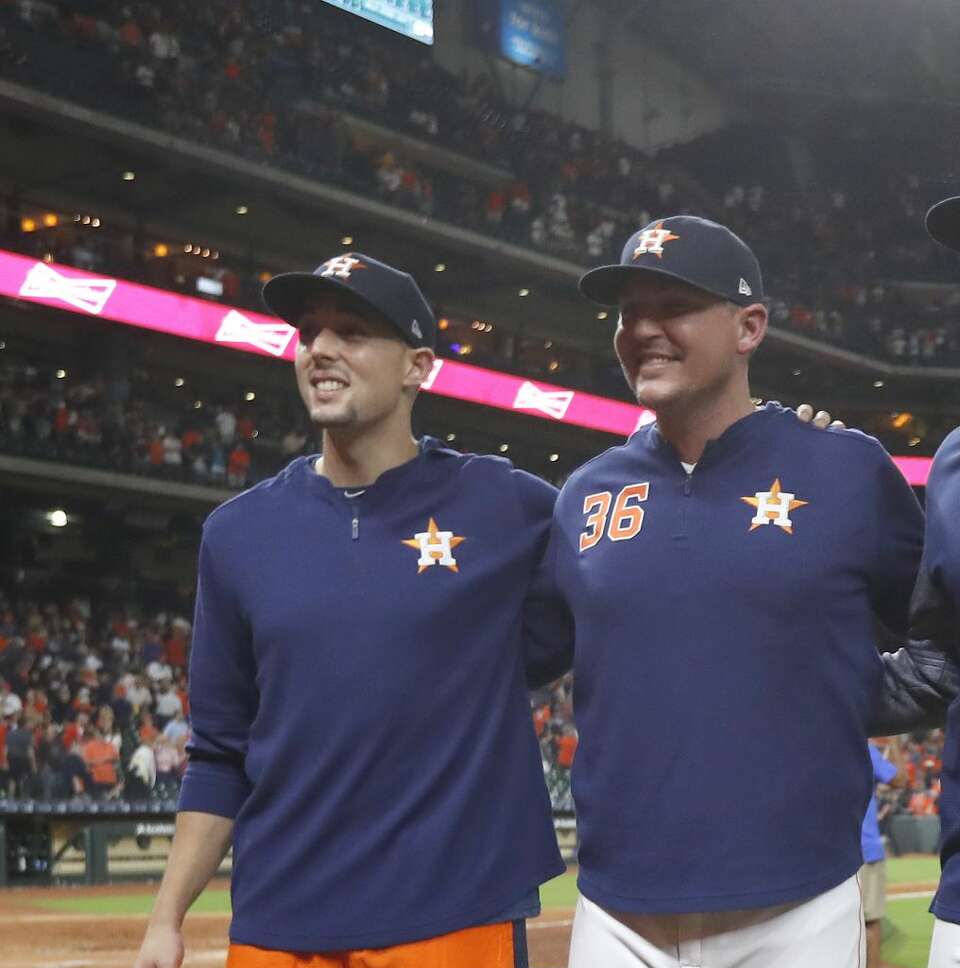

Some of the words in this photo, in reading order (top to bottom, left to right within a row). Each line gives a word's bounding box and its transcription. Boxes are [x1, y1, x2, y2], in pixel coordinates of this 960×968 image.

[634, 229, 672, 255] H
[320, 256, 360, 279] H
[579, 481, 650, 552] 36
[751, 491, 797, 527] H
[413, 530, 457, 567] H
